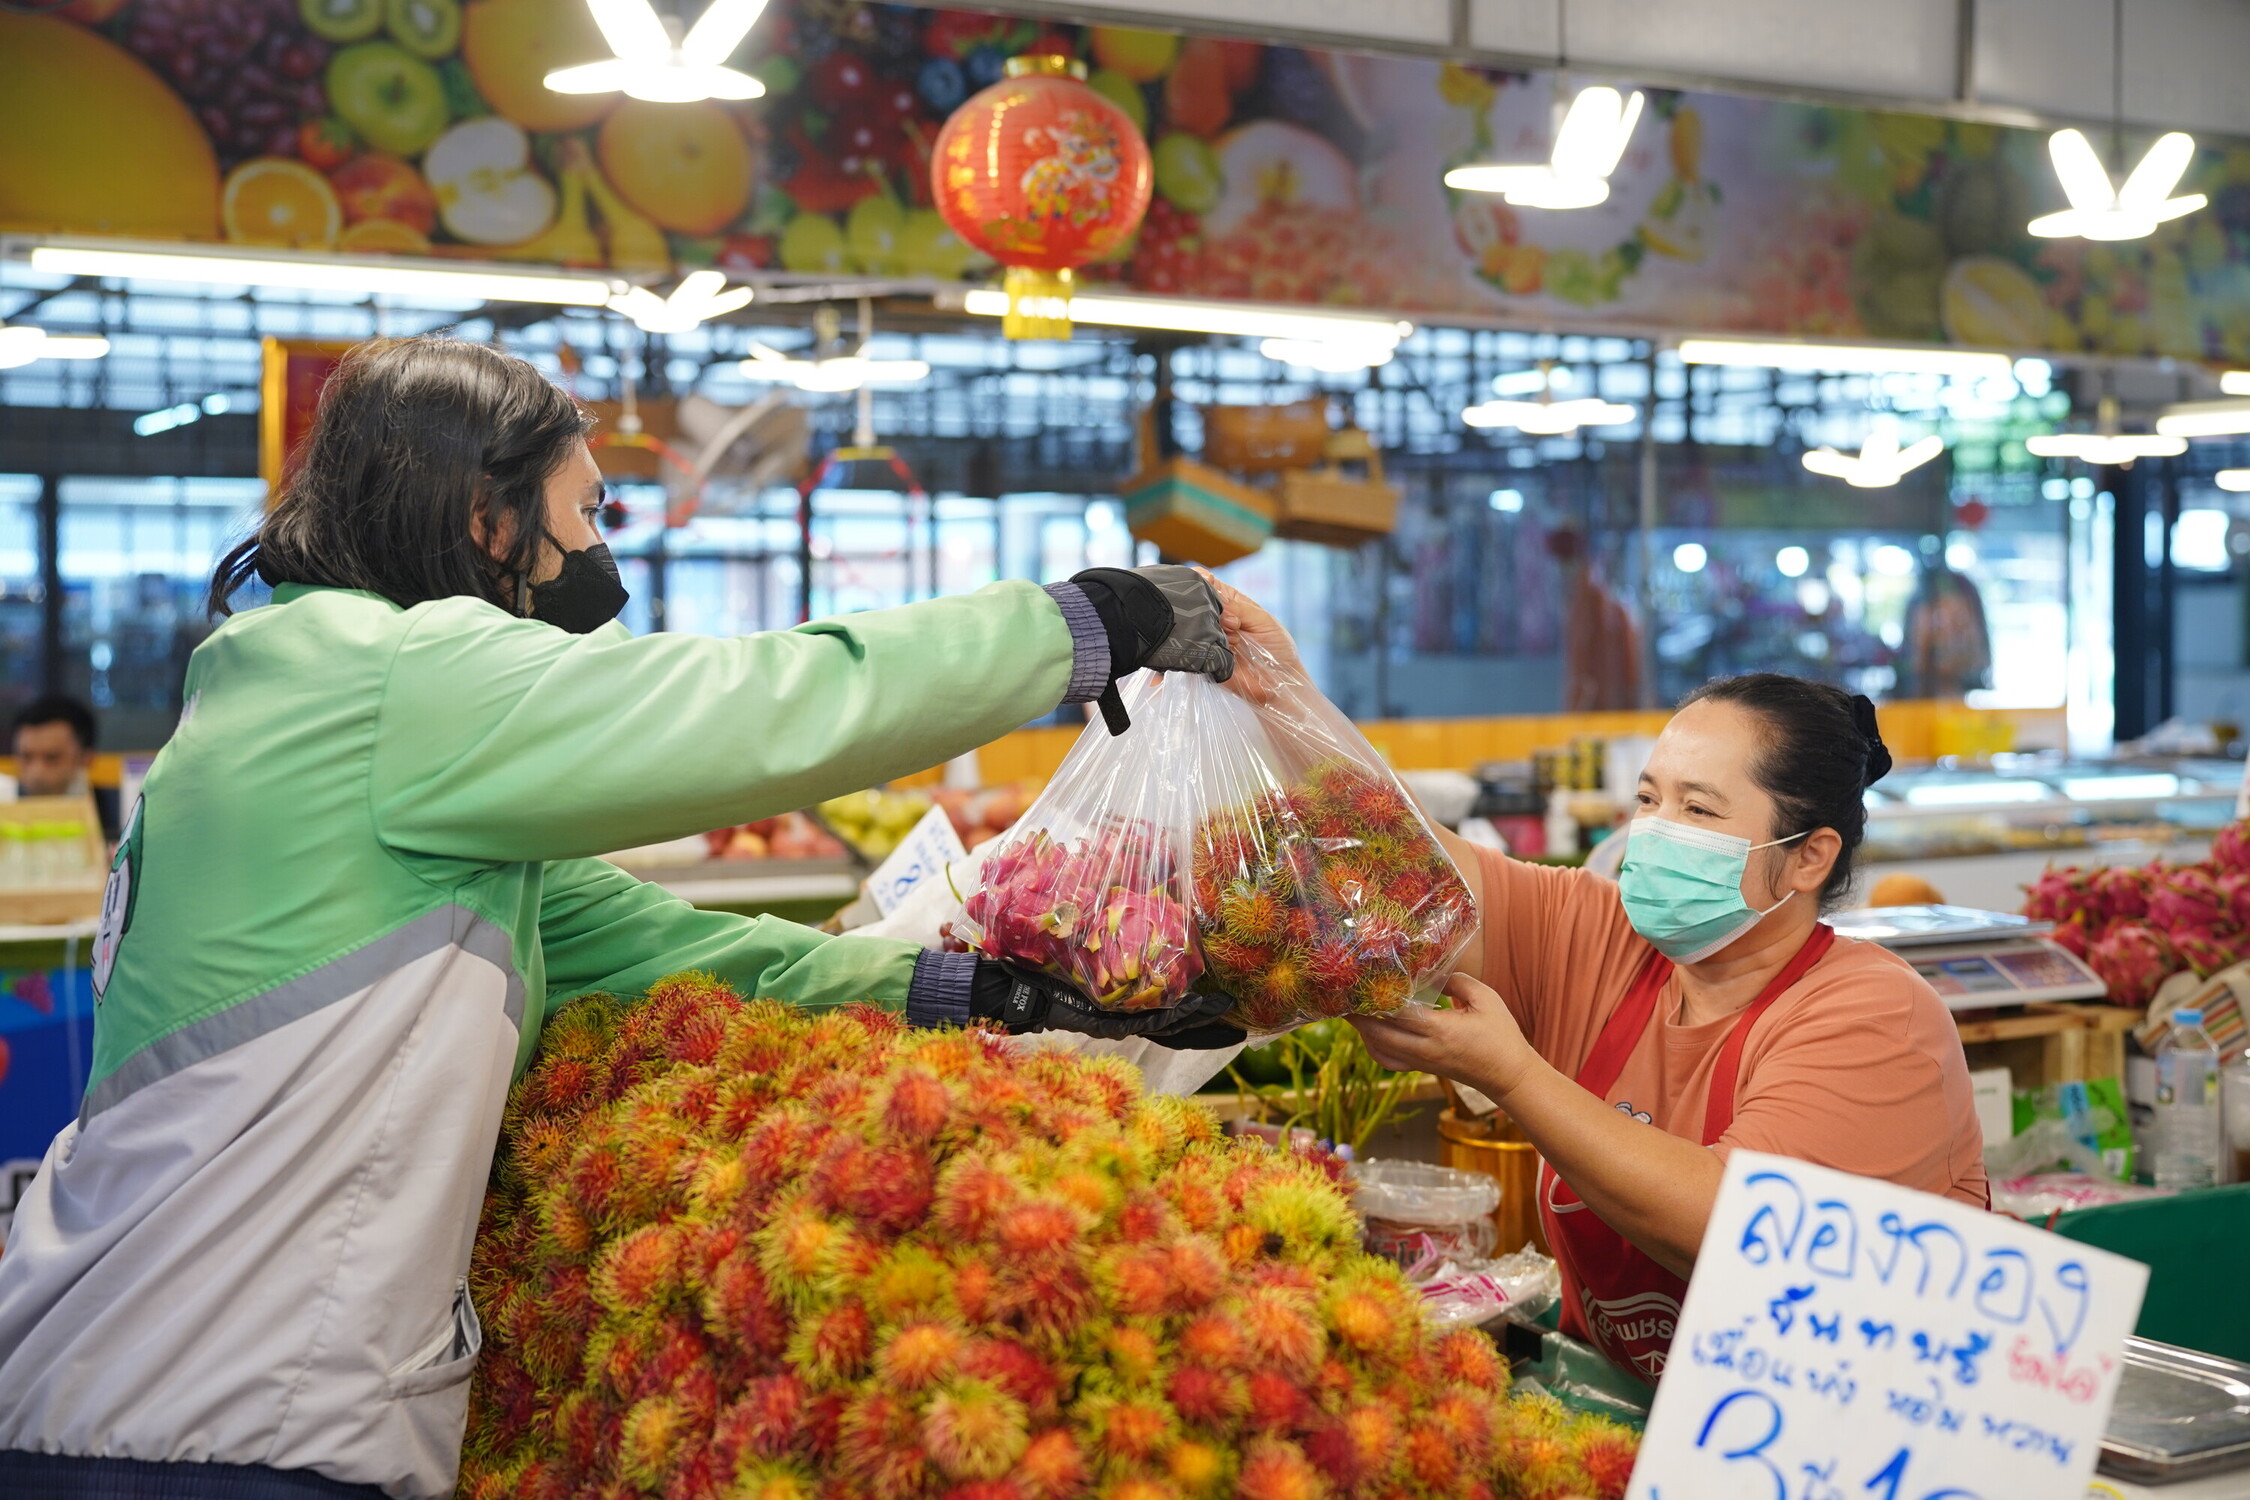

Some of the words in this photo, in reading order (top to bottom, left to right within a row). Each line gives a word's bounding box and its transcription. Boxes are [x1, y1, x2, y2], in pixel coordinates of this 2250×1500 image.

[1016, 994, 1029, 1012] FOX
[1740, 1172, 2090, 1354] ลองกอง
